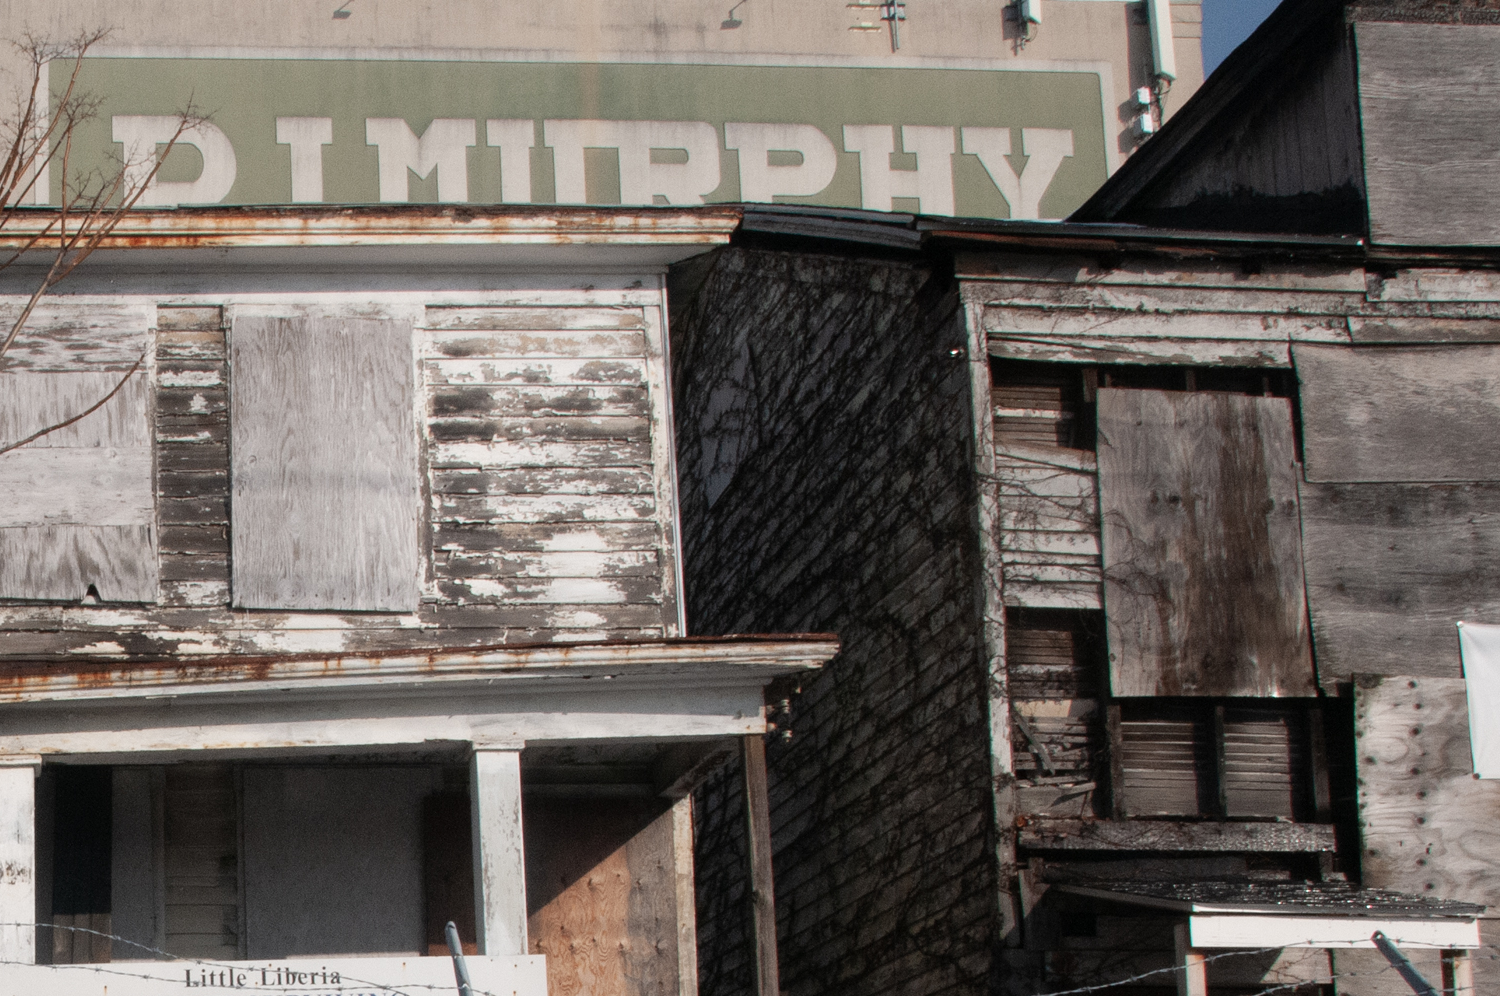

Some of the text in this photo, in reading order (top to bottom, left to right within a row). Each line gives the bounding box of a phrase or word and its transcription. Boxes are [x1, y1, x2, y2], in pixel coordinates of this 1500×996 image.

[365, 118, 1074, 220] MURPHY
[184, 967, 341, 988] Little Liberia
